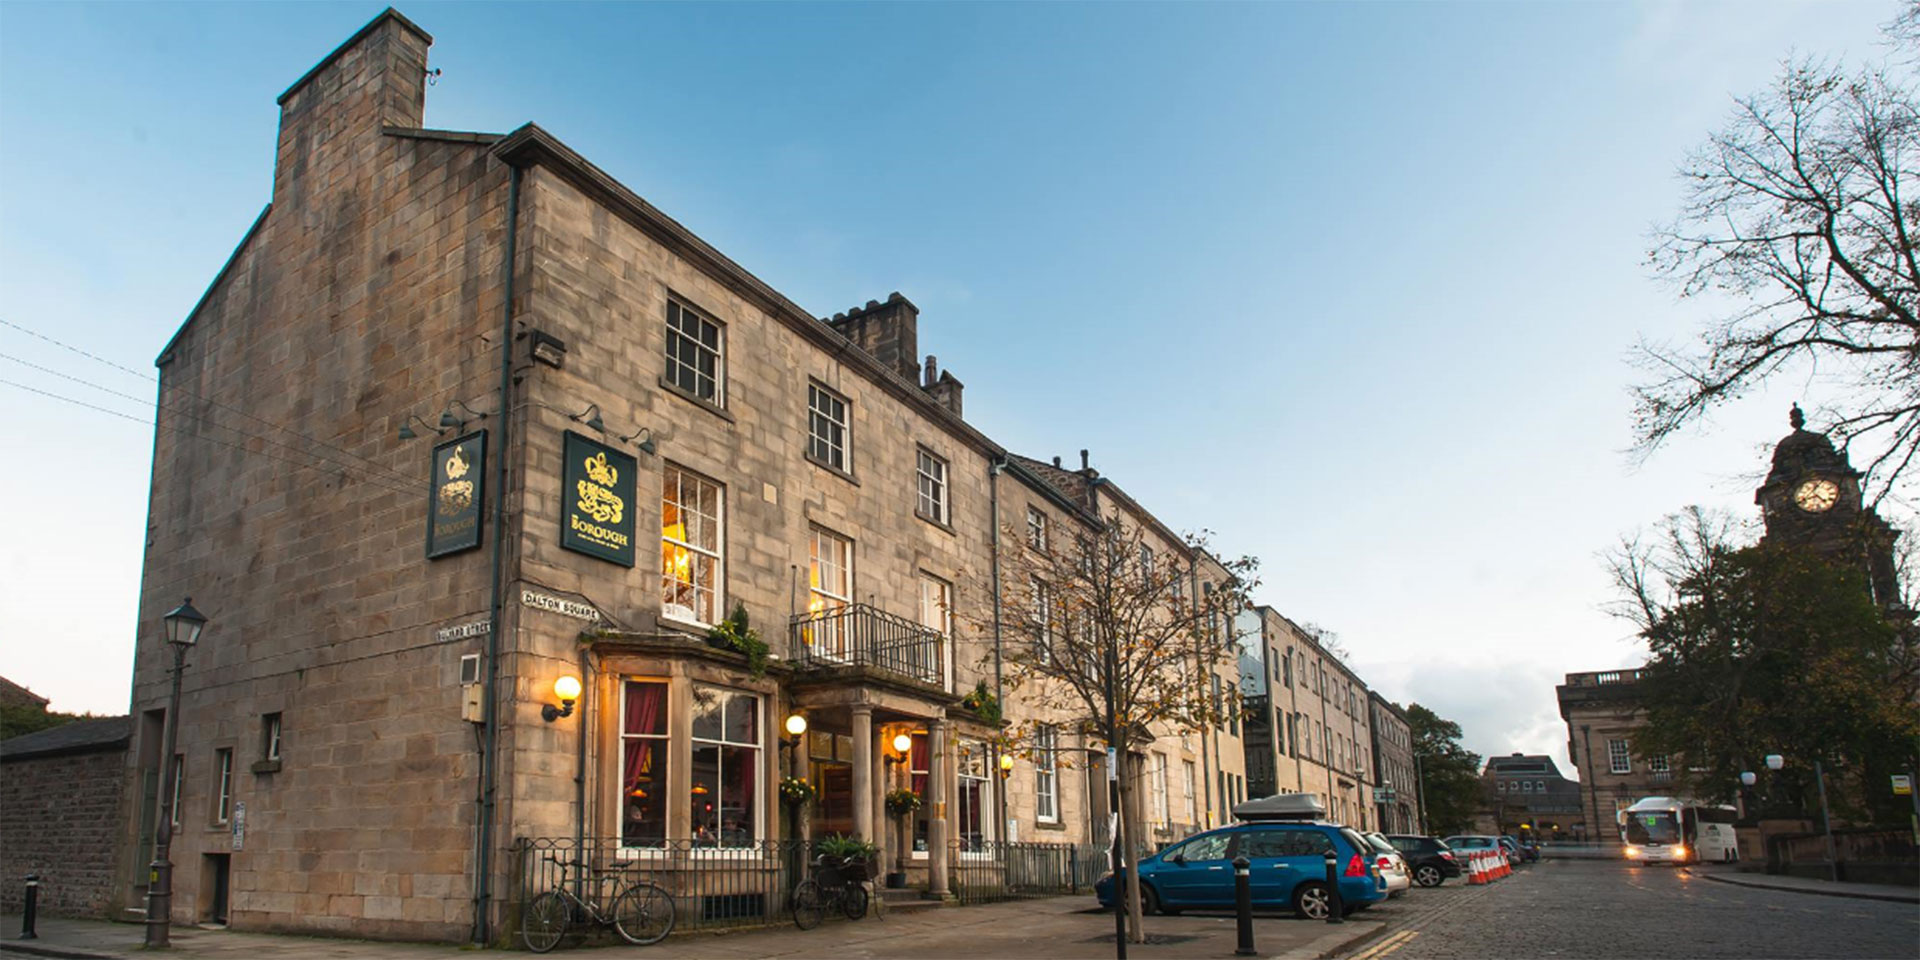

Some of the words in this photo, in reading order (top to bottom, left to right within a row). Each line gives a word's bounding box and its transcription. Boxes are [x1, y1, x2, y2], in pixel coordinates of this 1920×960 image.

[571, 516, 628, 546] BOROUGH
[525, 594, 560, 609] DALTON
[563, 603, 596, 618] SQUARE
